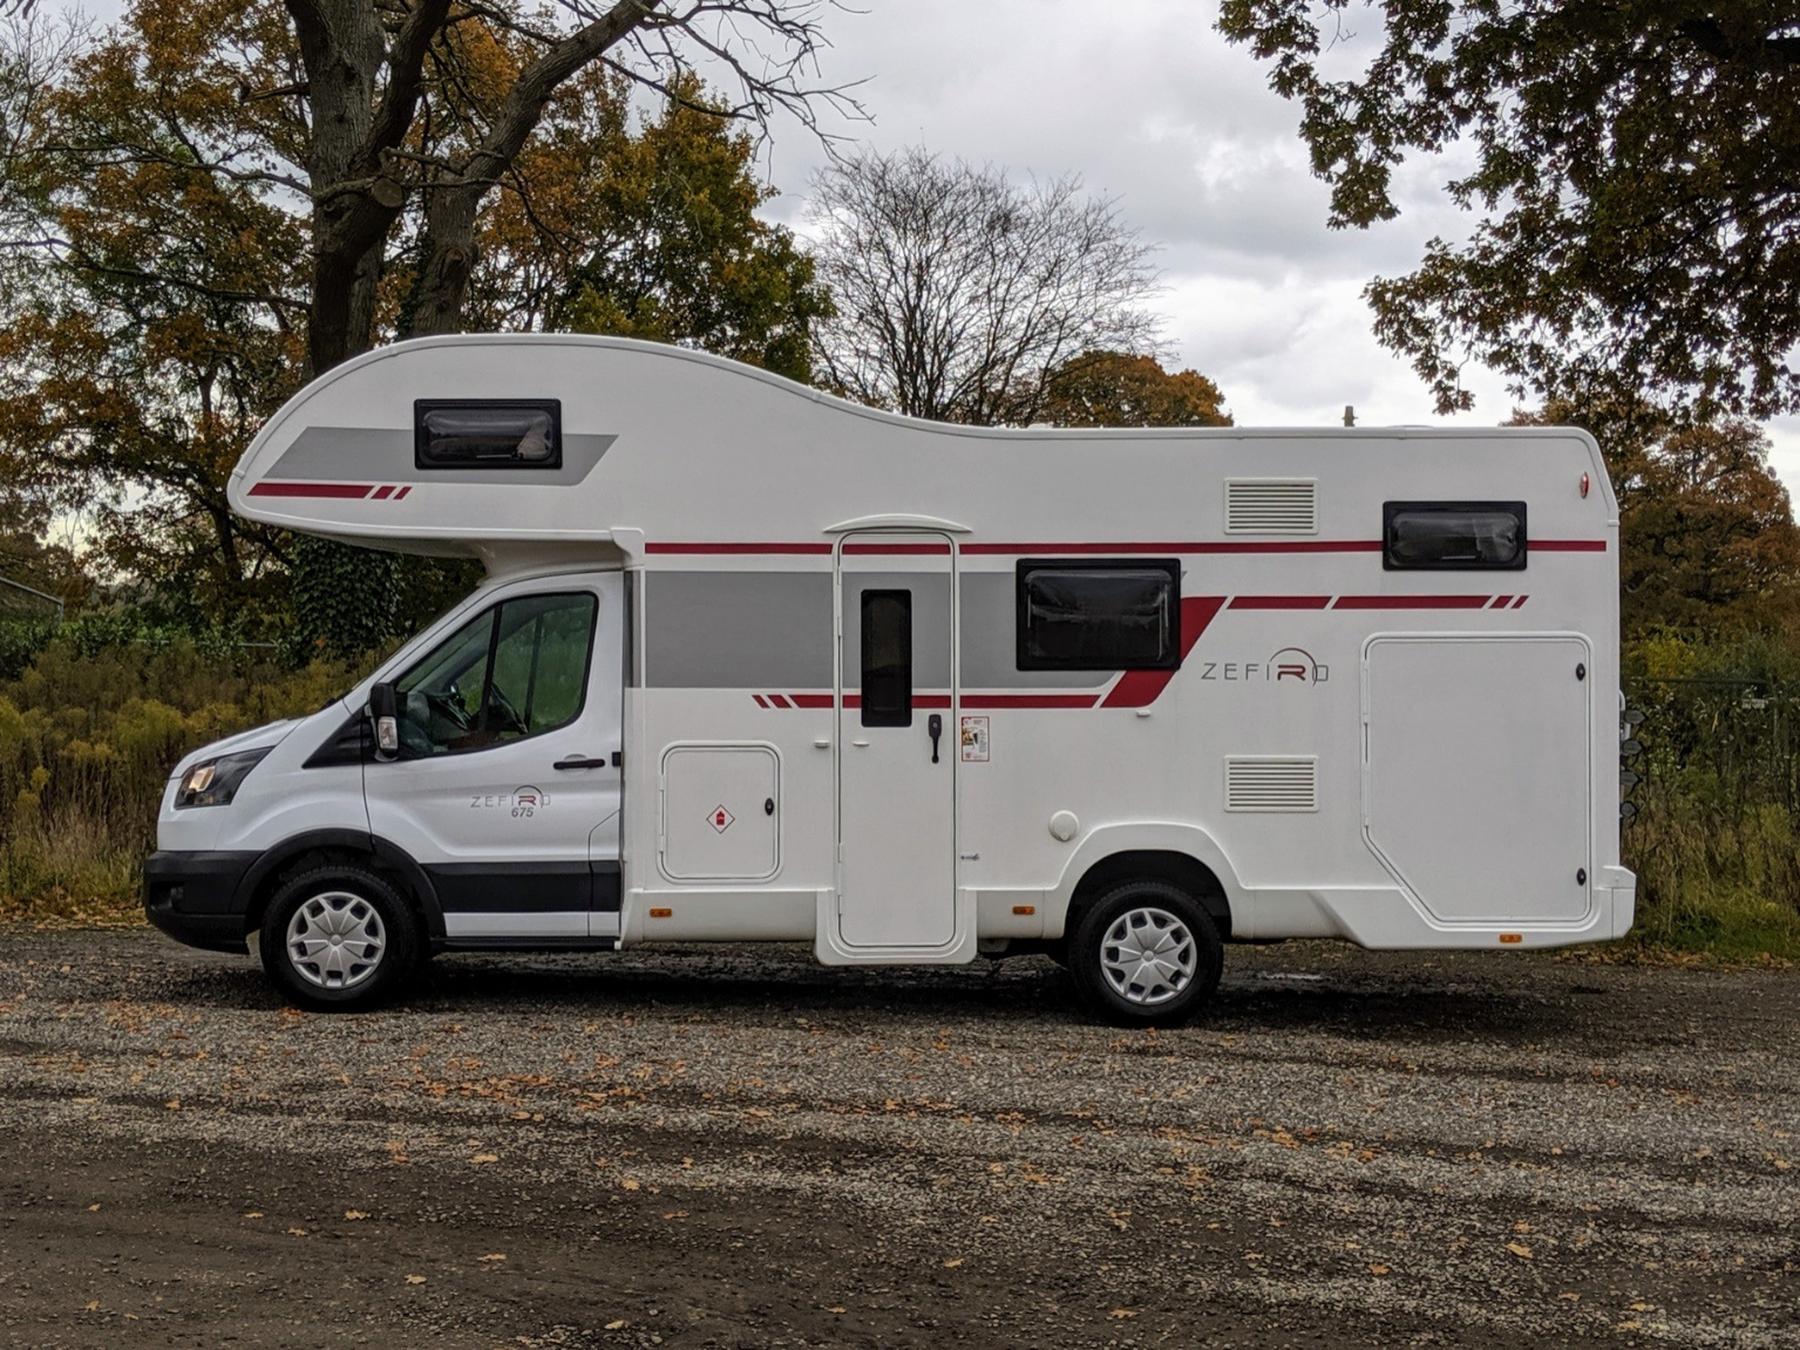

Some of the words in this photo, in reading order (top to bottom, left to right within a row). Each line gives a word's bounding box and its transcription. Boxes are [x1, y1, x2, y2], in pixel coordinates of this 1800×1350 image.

[1200, 660, 1329, 683] ZEFIRO
[470, 793, 551, 808] ZEFIRO
[511, 807, 534, 818] 675
